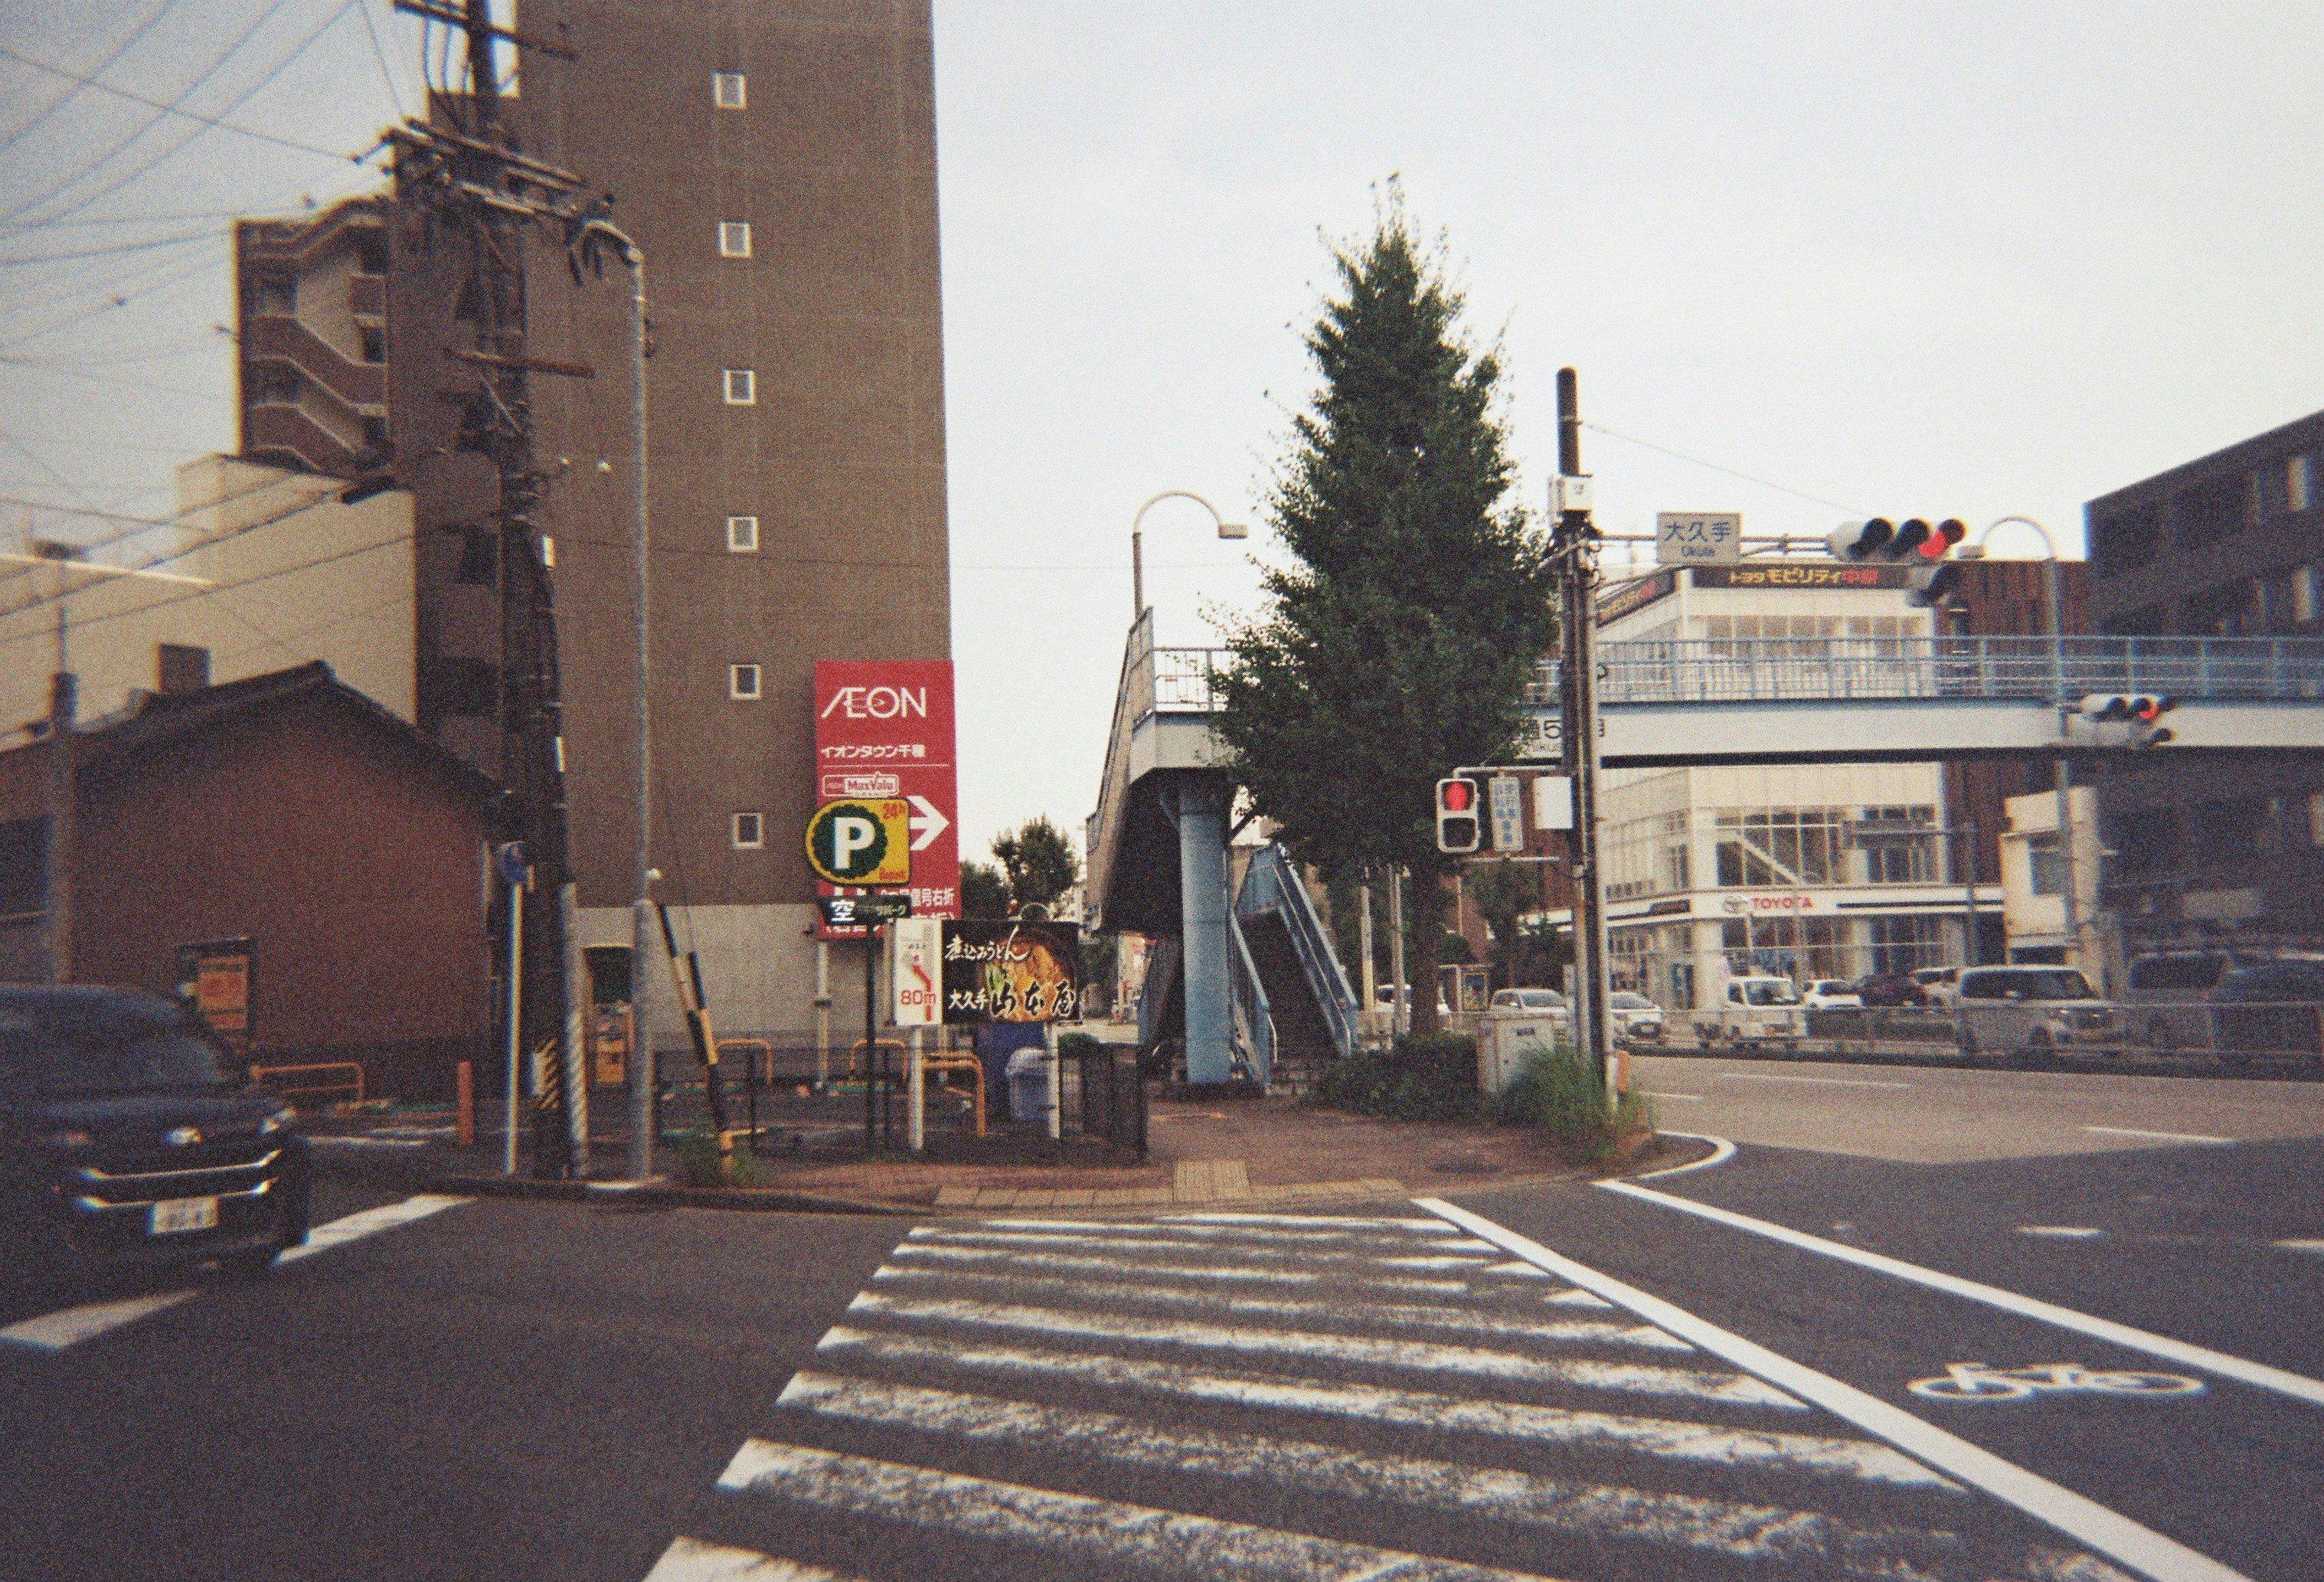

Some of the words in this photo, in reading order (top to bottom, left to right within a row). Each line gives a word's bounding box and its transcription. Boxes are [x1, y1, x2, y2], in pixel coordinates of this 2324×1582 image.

[1664, 521, 1731, 543] 大久手
[834, 816, 876, 869] P
[831, 899, 856, 922] 空
[1751, 897, 1813, 910] TOYOTA
[901, 989, 936, 1006] 80m
